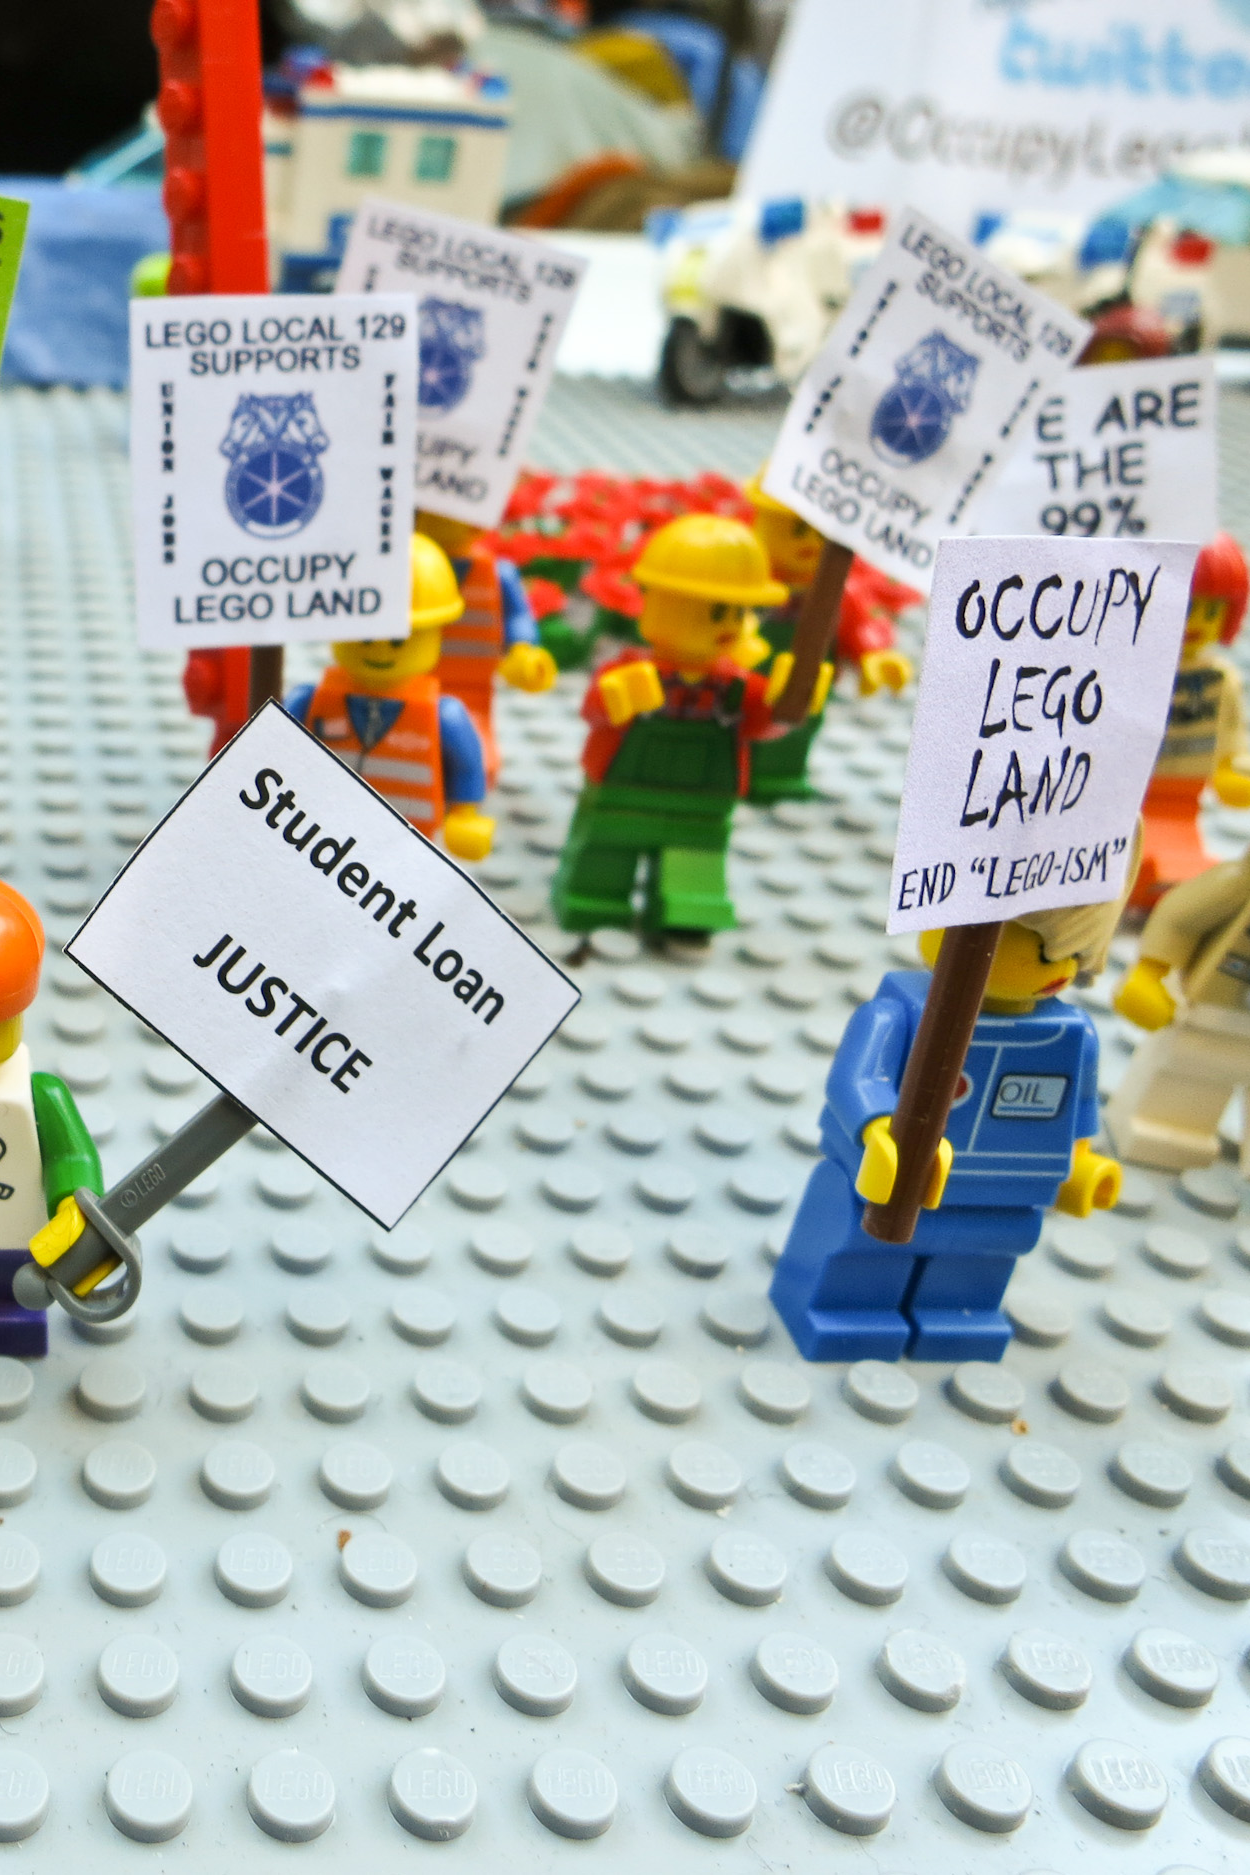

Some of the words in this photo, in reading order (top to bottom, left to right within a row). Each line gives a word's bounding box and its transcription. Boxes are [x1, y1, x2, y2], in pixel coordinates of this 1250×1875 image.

[1000, 14, 1250, 96] twitte
[367, 214, 437, 252] LEGO
[445, 238, 523, 281] LOCAL
[901, 224, 966, 280] LEGO
[965, 270, 1032, 331] LOCAL
[145, 320, 231, 348] LEGO
[243, 316, 344, 344] LOCAL
[357, 313, 406, 340] 129
[915, 271, 1030, 363] SUPPORTS
[190, 345, 361, 376] SUPPORTS
[1037, 395, 1065, 442] E
[1094, 381, 1200, 435] ARE
[417, 432, 476, 464] UPY
[1035, 442, 1144, 490] THE
[791, 464, 861, 526] LEGO
[865, 514, 935, 570] LAND
[820, 447, 933, 528] OCCUPY
[1040, 496, 1146, 537] 99%
[202, 552, 355, 587] OCCUPY
[175, 592, 274, 624] LEGO
[287, 587, 382, 619] LAND
[955, 564, 1161, 646] OCCUPY
[979, 658, 1103, 738] LEGO
[960, 745, 1091, 829] LAND
[239, 767, 417, 939] Student
[413, 921, 506, 1026] Loan
[897, 862, 956, 911] END
[192, 934, 373, 1094] JUSTICE
[1000, 1081, 1044, 1105] OIL
[404, 1770, 469, 1799] LEGO
